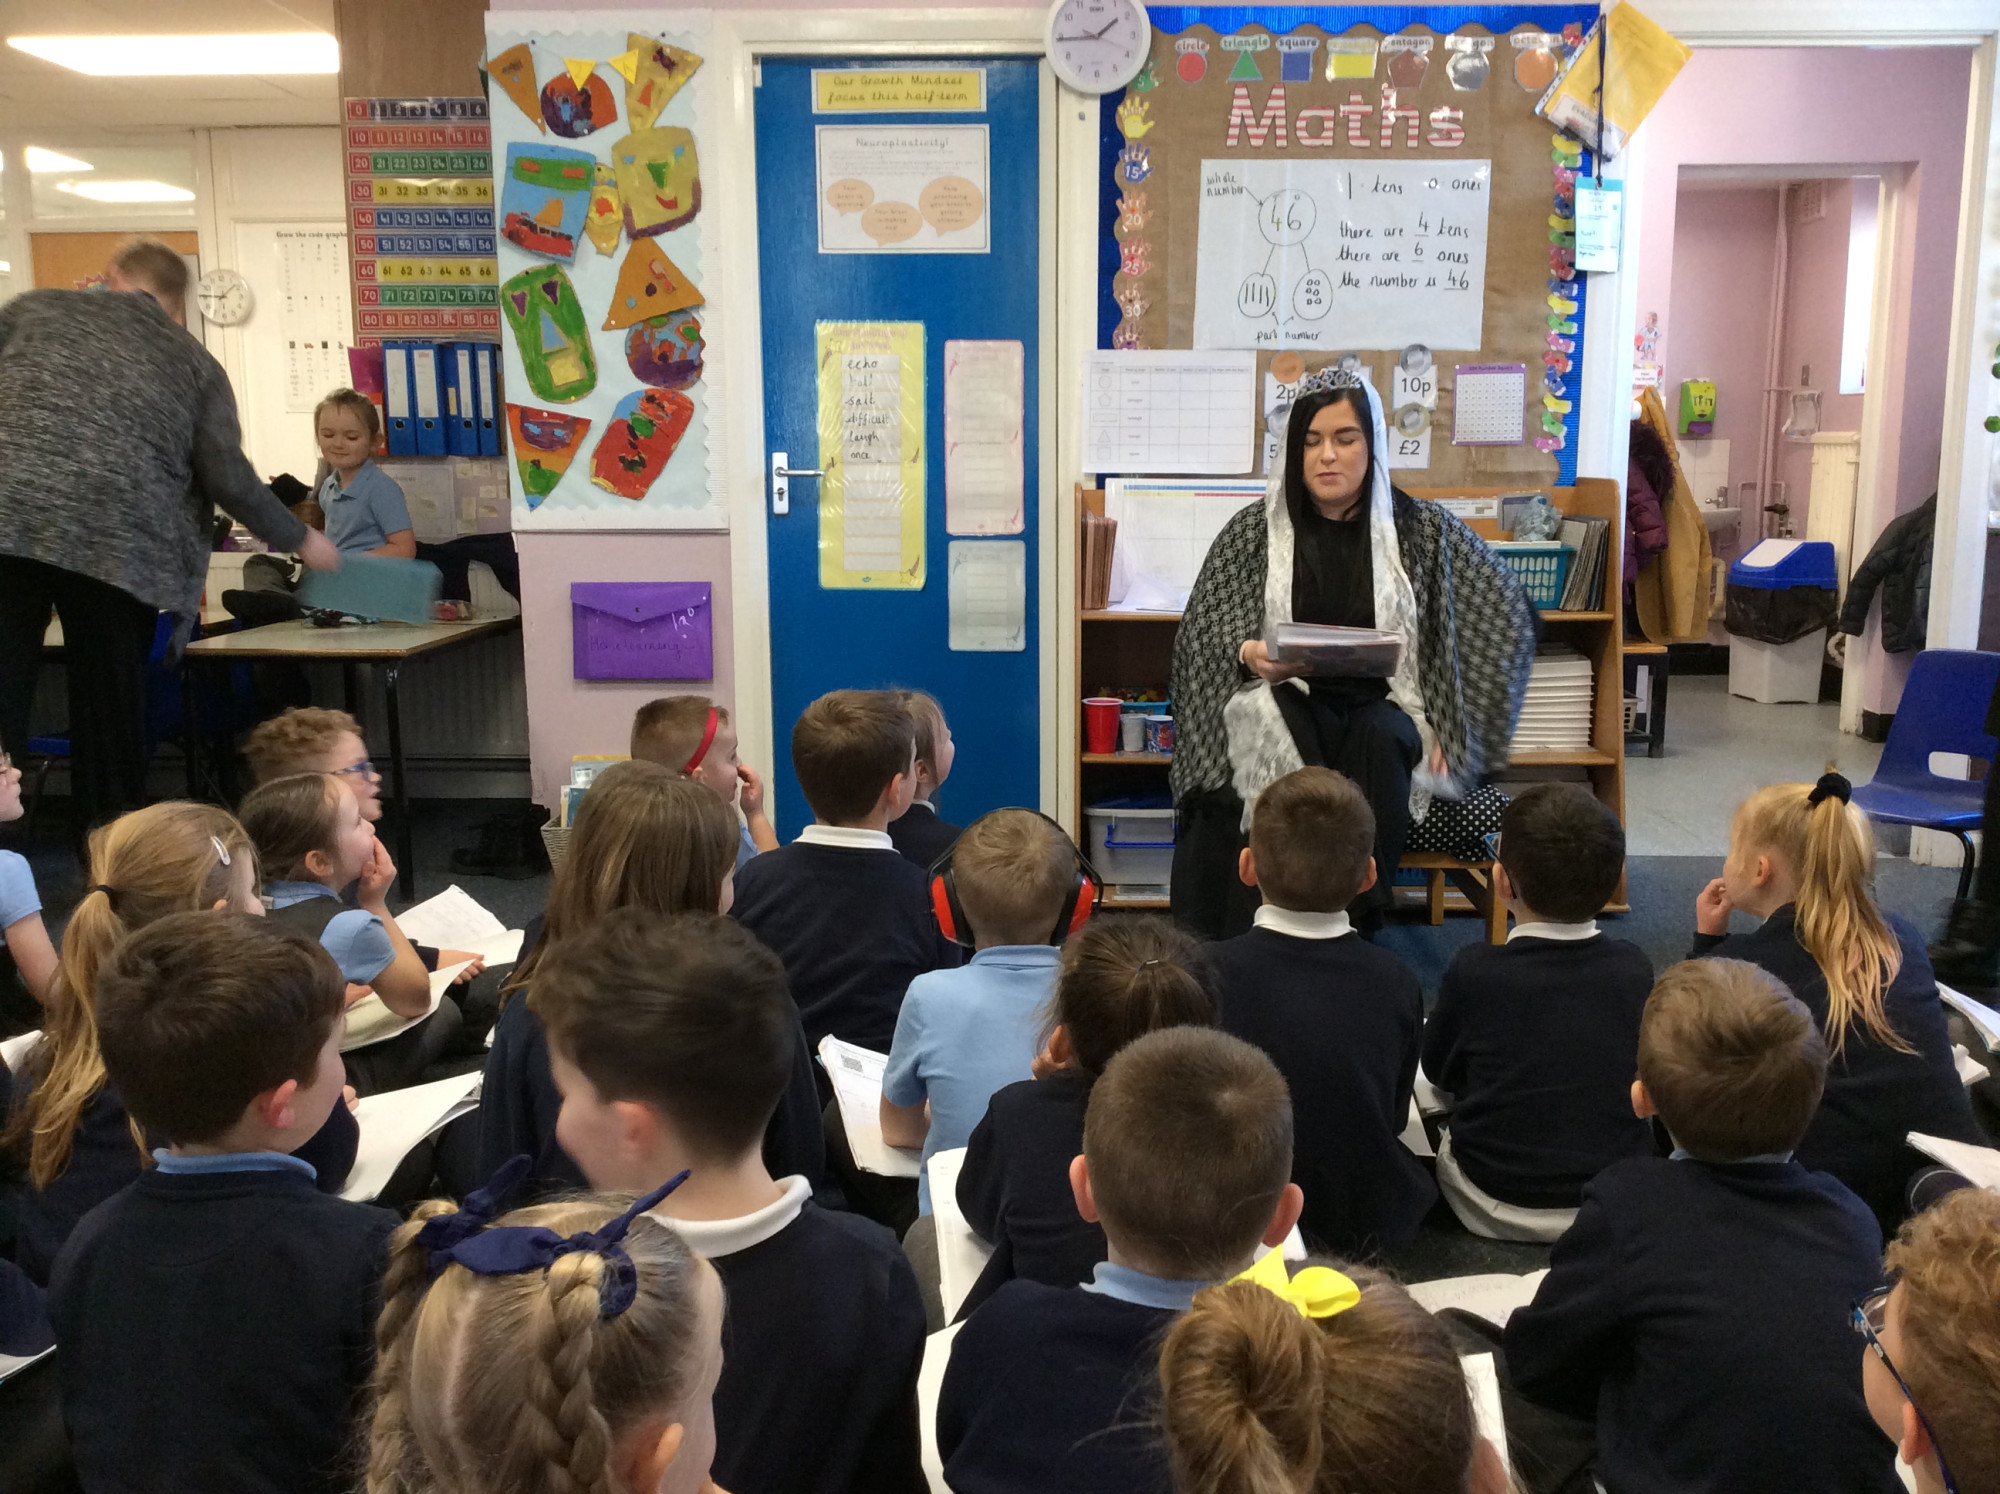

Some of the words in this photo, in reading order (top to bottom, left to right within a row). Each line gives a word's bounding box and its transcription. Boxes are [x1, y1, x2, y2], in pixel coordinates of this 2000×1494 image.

[1064, 13, 1073, 21] 10
[1124, 11, 1131, 20] 2
[1130, 31, 1136, 40] 3
[1176, 40, 1206, 51] circle
[1223, 37, 1268, 49] triangle
[1279, 38, 1317, 50] square
[1112, 63, 1118, 72] 5
[833, 76, 855, 86] Our
[861, 75, 904, 86] Growth
[911, 75, 963, 86] Mindset
[827, 91, 866, 105] focus
[871, 90, 899, 101] this
[356, 105, 362, 115] 0
[395, 105, 401, 115] 2
[456, 105, 462, 115] 5
[475, 105, 481, 115] 6
[1226, 83, 1465, 149] Maths
[355, 133, 366, 143] 10
[377, 133, 384, 143] 11
[393, 133, 404, 143] 12
[413, 133, 423, 143] 13
[432, 133, 443, 143] 14
[453, 133, 463, 143] 15
[473, 133, 483, 143] 16
[355, 158, 368, 168] 20
[376, 158, 386, 168] 21
[393, 158, 406, 168] 22
[412, 158, 425, 168] 23
[433, 158, 445, 168] 24
[452, 158, 464, 168] 25
[472, 158, 485, 168] 26
[1125, 165, 1140, 179] 15
[1371, 174, 1403, 195] tens
[1451, 179, 1481, 191] ones
[357, 186, 369, 196] 30
[378, 186, 387, 196] 31
[396, 186, 408, 196] 32
[416, 186, 428, 196] 33
[436, 186, 448, 196] 34
[456, 186, 468, 196] 35
[476, 186, 488, 196] 36
[1206, 185, 1244, 197] number
[359, 214, 371, 224] 40
[380, 214, 390, 224] 41
[398, 214, 410, 224] 42
[417, 214, 430, 224] 43
[436, 214, 449, 224] 44
[456, 214, 469, 224] 45
[476, 214, 489, 224] 46
[1125, 214, 1141, 226] 20
[1271, 202, 1302, 232] 46
[1339, 221, 1373, 239] there
[1384, 227, 1404, 237] are
[1418, 211, 1429, 233] 4
[1437, 217, 1469, 239] tens
[361, 240, 373, 249] 50
[382, 240, 391, 249] 51
[400, 240, 412, 249] 52
[418, 240, 431, 249] 53
[438, 240, 451, 249] 54
[458, 240, 471, 249] 55
[478, 240, 491, 249] 56
[1336, 244, 1372, 262] there
[1382, 252, 1401, 262] are
[1414, 241, 1424, 256] 6
[1436, 250, 1469, 264] ones
[361, 266, 373, 276] 60
[383, 266, 392, 276] 61
[400, 266, 412, 276] 62
[420, 266, 432, 276] 63
[439, 266, 451, 276] 64
[459, 266, 471, 276] 65
[479, 266, 491, 276] 66
[1123, 261, 1140, 275] 25
[1338, 271, 1360, 288] the
[1370, 272, 1418, 288] number
[1447, 268, 1469, 290] 46
[363, 291, 376, 301] 70
[385, 291, 394, 301] 71
[402, 291, 415, 301] 72
[422, 291, 434, 301] 73
[442, 291, 454, 301] 74
[461, 291, 473, 301] 75
[481, 291, 493, 301] 76
[1126, 305, 1141, 317] 30
[364, 315, 377, 324] 80
[386, 315, 395, 324] 81
[404, 315, 416, 324] 82
[423, 315, 436, 324] 83
[443, 315, 456, 324] 84
[463, 315, 475, 324] 85
[483, 315, 495, 324] 86
[1285, 331, 1322, 341] number
[847, 357, 879, 370] echo
[1402, 377, 1431, 397] 10p
[845, 392, 876, 406] salt
[1276, 384, 1297, 405] 2p
[849, 431, 880, 446] laugh
[1399, 440, 1421, 456] £2
[850, 452, 871, 460] once
